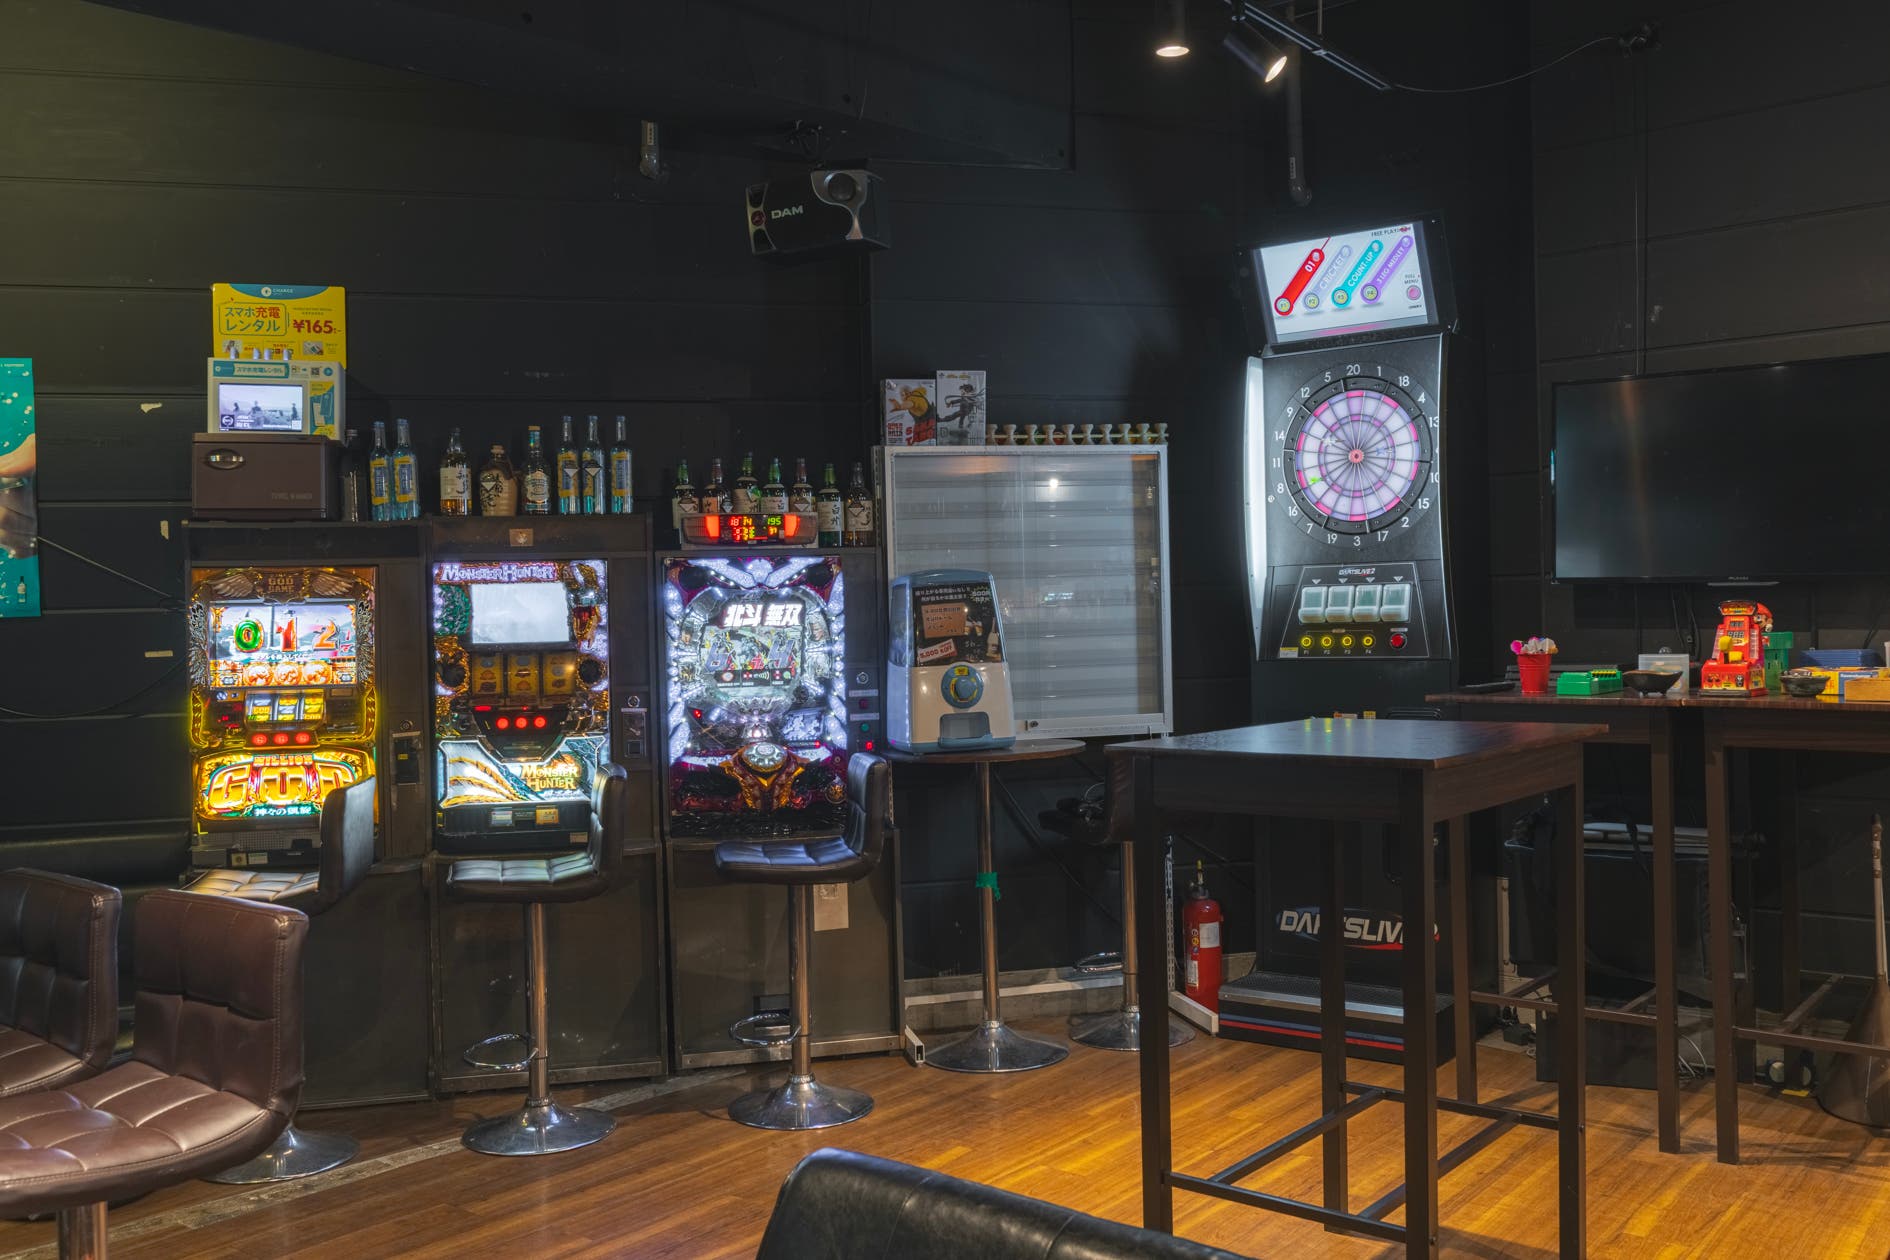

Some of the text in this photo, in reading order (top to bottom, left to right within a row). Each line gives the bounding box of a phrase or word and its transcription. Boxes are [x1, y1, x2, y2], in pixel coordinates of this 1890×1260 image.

[771, 205, 804, 219] DAM
[1305, 261, 1316, 273] 01
[1320, 255, 1346, 289] CRICKET
[1347, 251, 1374, 287] COUNT-UP
[224, 306, 281, 319] スマホ充電
[226, 319, 281, 332] レンタル
[293, 319, 333, 334] ¥165
[1346, 364, 1361, 375] 20
[1377, 366, 1382, 376] 1
[1324, 372, 1331, 382] 5
[1399, 376, 1410, 387] 18
[1300, 387, 1310, 398] 12
[1418, 392, 1426, 403] 4
[1286, 407, 1293, 417] 9
[1429, 417, 1439, 428] 13
[1274, 431, 1285, 441] 14
[1272, 458, 1281, 468] 11
[1277, 483, 1284, 493] 8
[1418, 498, 1430, 509] 15
[1288, 506, 1298, 516] 16
[1401, 517, 1410, 528] 2
[1306, 524, 1314, 534] 7
[1327, 533, 1337, 544] 19
[1353, 536, 1361, 546] 3
[1377, 530, 1389, 541] 17
[441, 563, 556, 581] MONSTER HUNTER
[268, 577, 294, 586] GOD
[724, 603, 803, 627] 北斗無双
[234, 617, 340, 653] 0 1 2
[253, 755, 314, 766] MILLION
[521, 764, 579, 778] MONSTER
[526, 777, 576, 792] HUNTER
